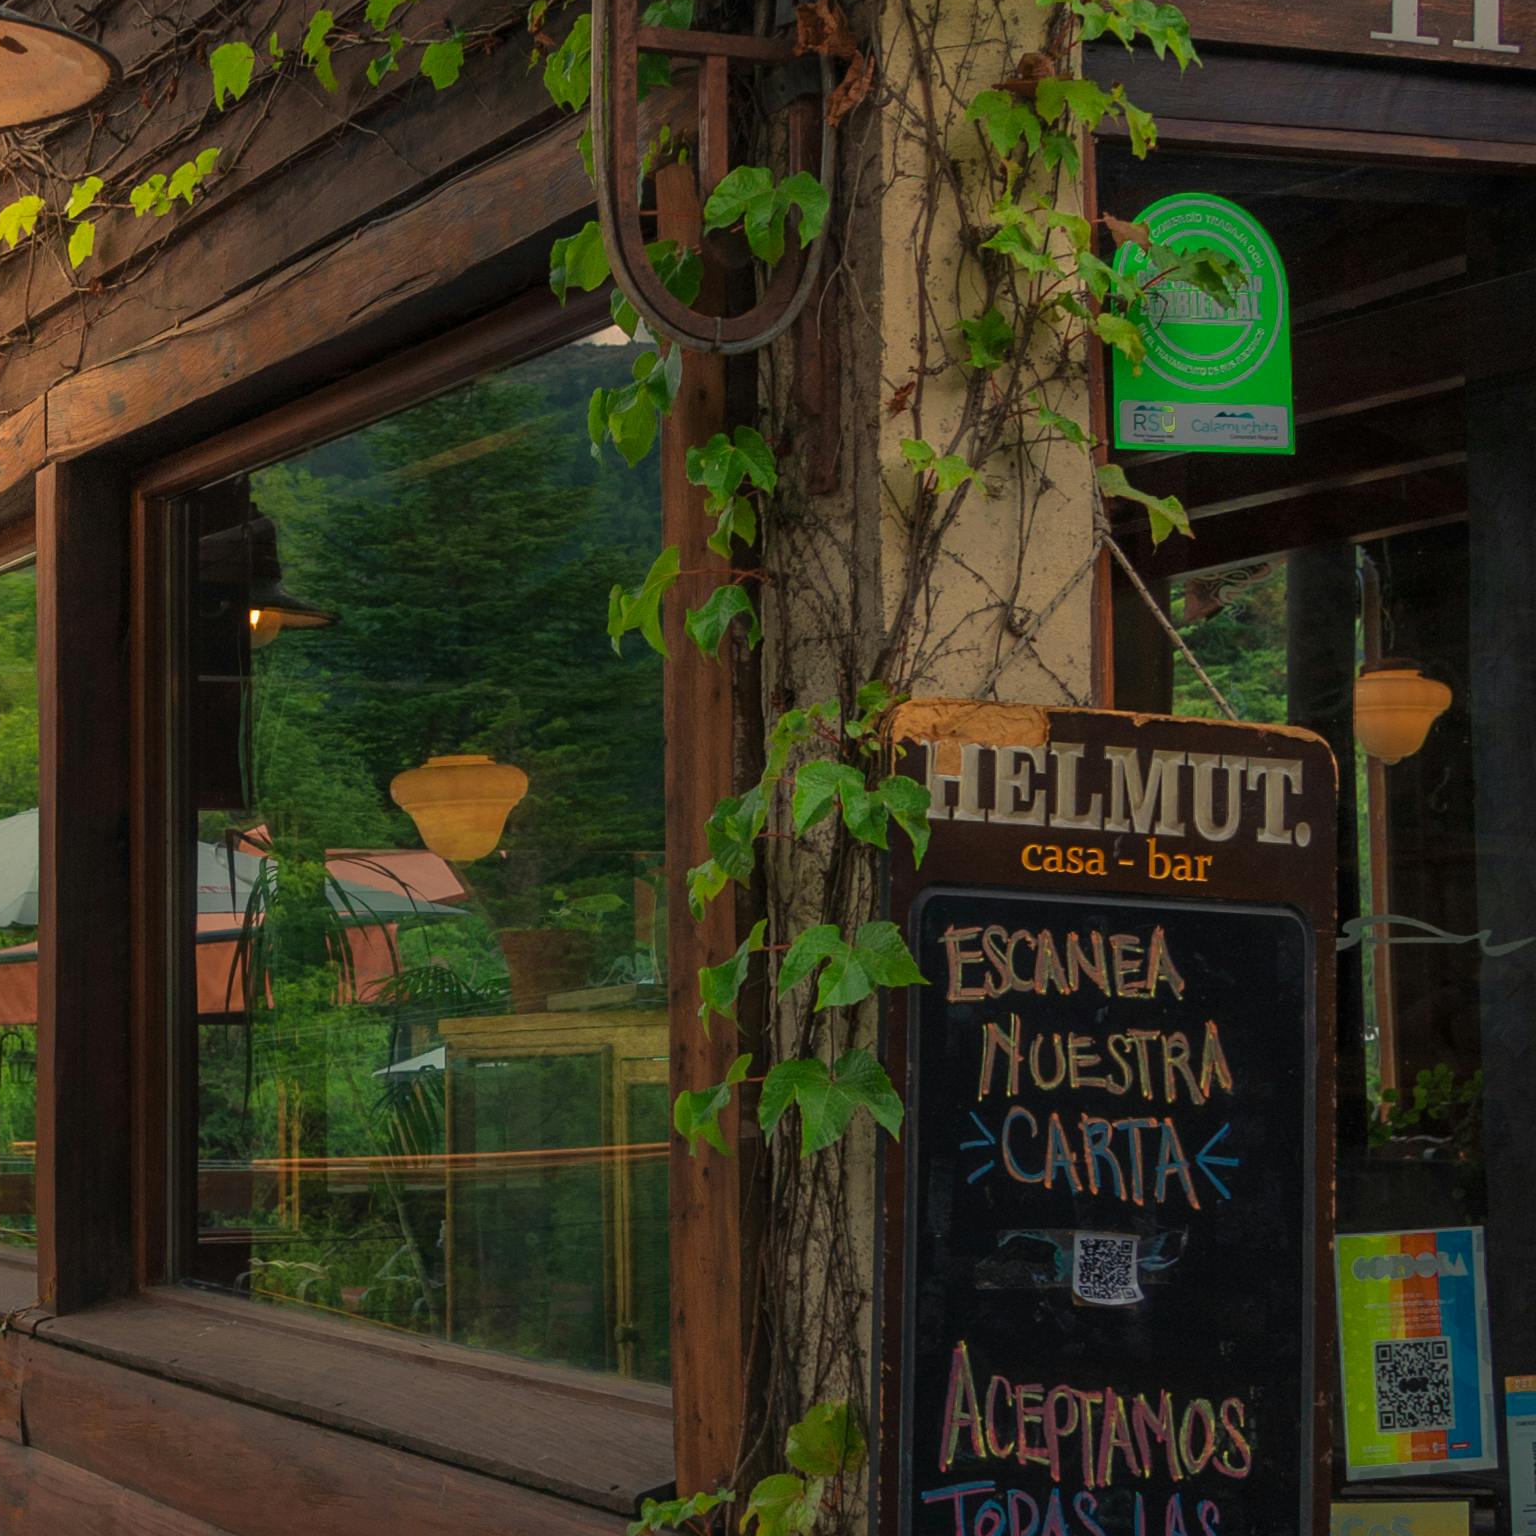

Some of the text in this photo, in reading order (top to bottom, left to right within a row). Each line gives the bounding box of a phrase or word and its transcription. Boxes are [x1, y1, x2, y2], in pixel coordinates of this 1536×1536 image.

[1133, 413, 1176, 433] RSU
[1191, 418, 1279, 434] Calamuchita
[1021, 838, 1107, 875] casa
[1147, 839, 1213, 882] bar
[939, 924, 1186, 1004] ESCANEA
[977, 1012, 1235, 1106] NUESTRA
[1001, 1105, 1202, 1210] CARTA
[939, 1339, 1253, 1490] ACEPTAMOS
